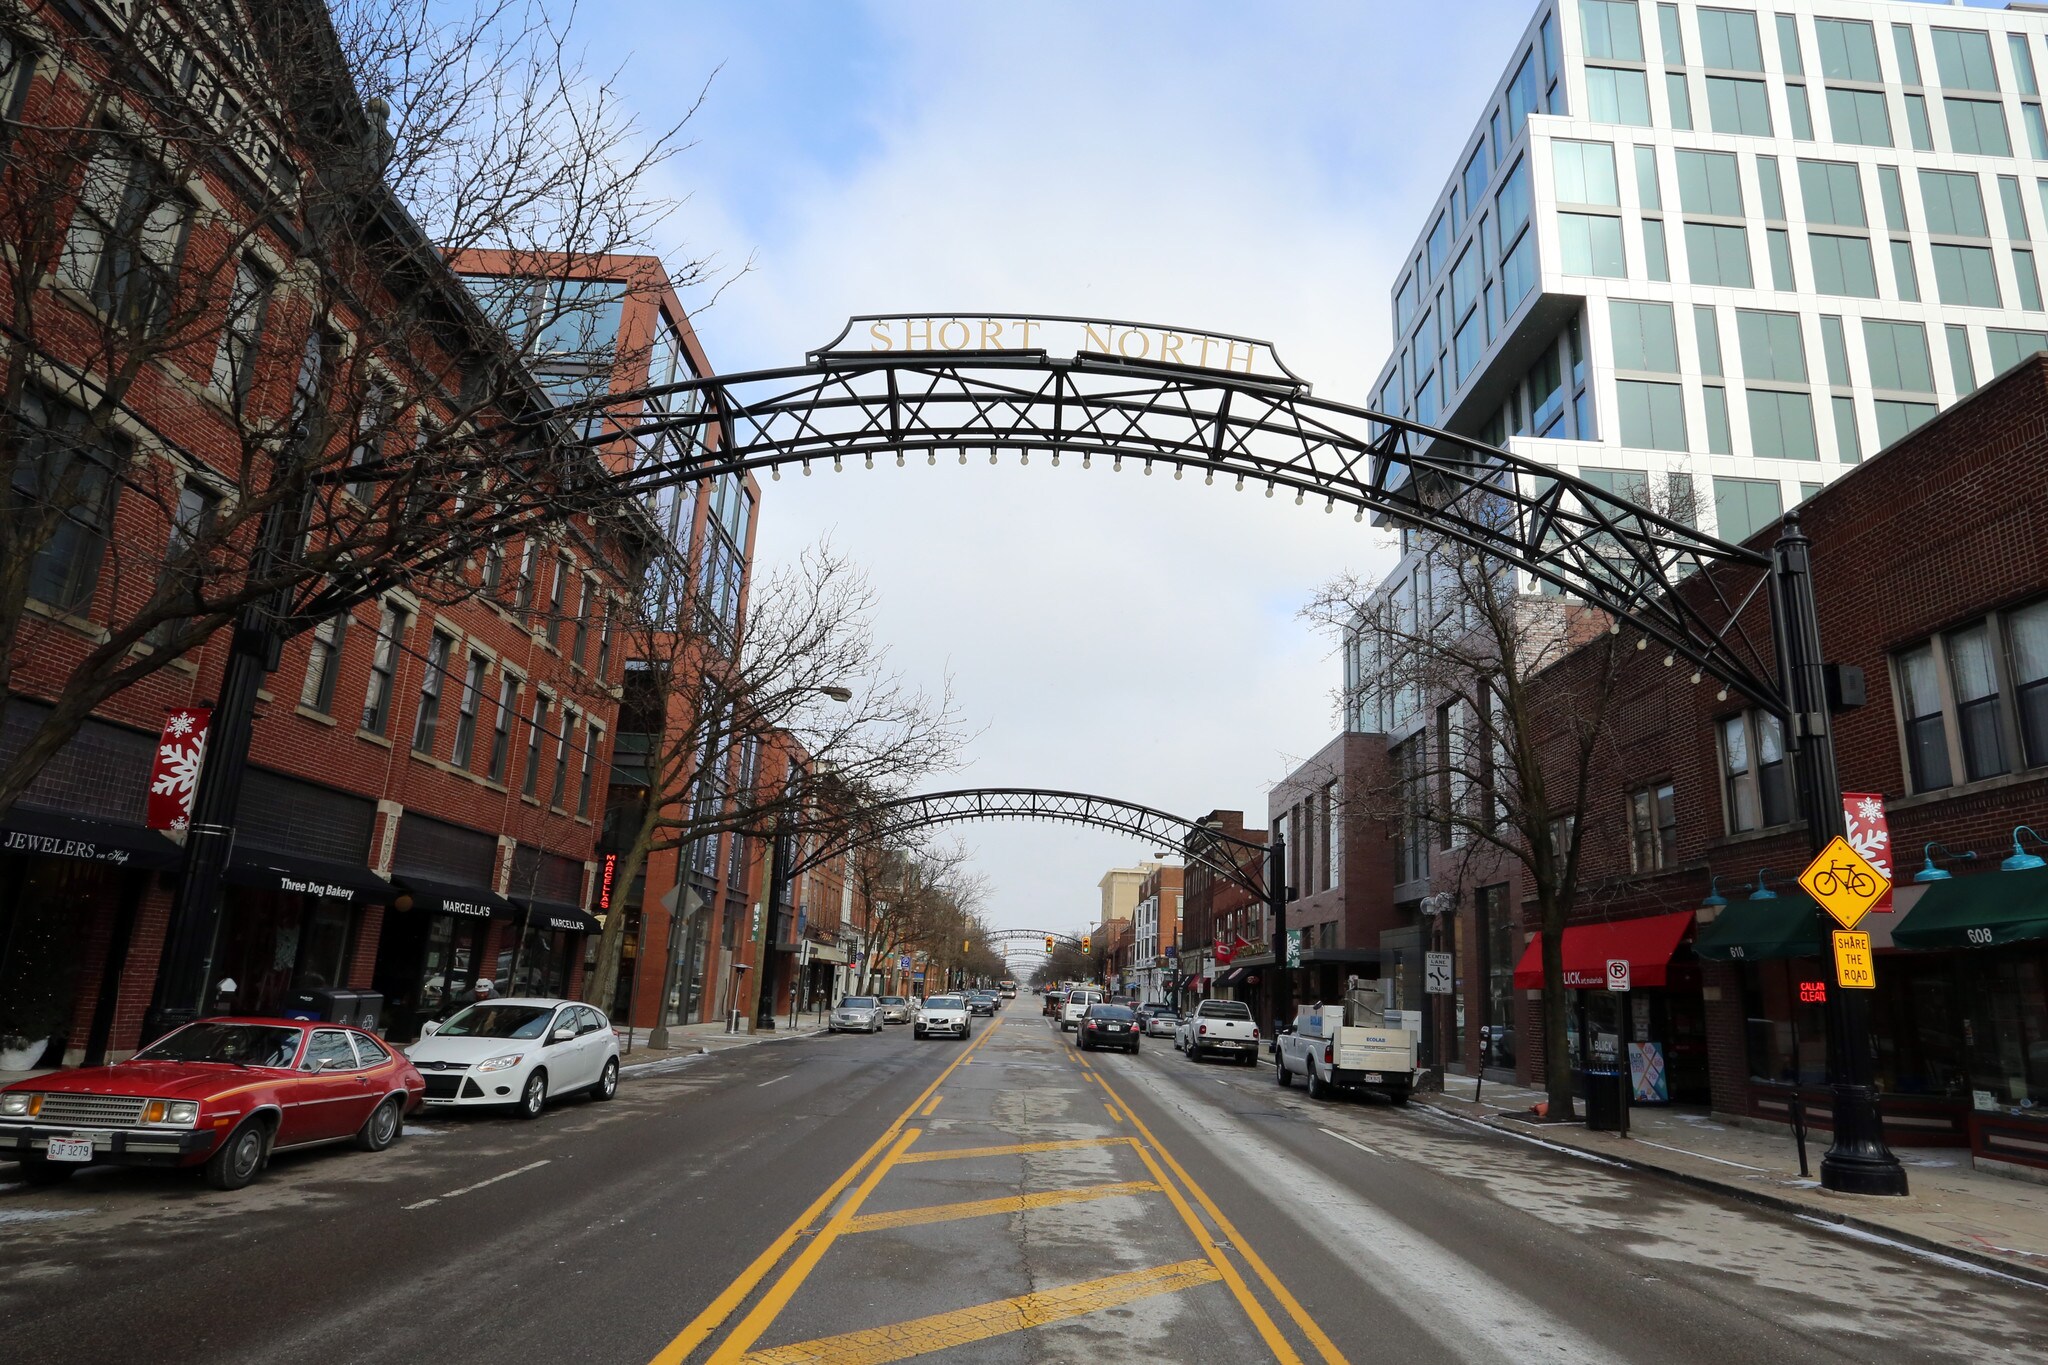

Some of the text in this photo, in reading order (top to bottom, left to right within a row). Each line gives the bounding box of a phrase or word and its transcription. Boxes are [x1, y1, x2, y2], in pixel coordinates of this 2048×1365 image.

[869, 320, 1259, 374] SHORT NORTH
[4, 832, 95, 858] JEWELERS
[107, 850, 129, 865] High
[281, 877, 354, 900] Three Dog Bakery
[443, 900, 490, 917] MARCELLA'S
[550, 918, 585, 930] MARCELLA'S
[1967, 928, 1992, 943] 608
[1838, 938, 1867, 950] SHARE
[1730, 947, 1744, 958] 610
[1846, 954, 1862, 965] THE
[1563, 972, 1580, 984] LICK
[1844, 970, 1868, 981] ROAD
[1594, 1040, 1613, 1052] BLICK
[50, 1143, 89, 1157] GJF 3279
